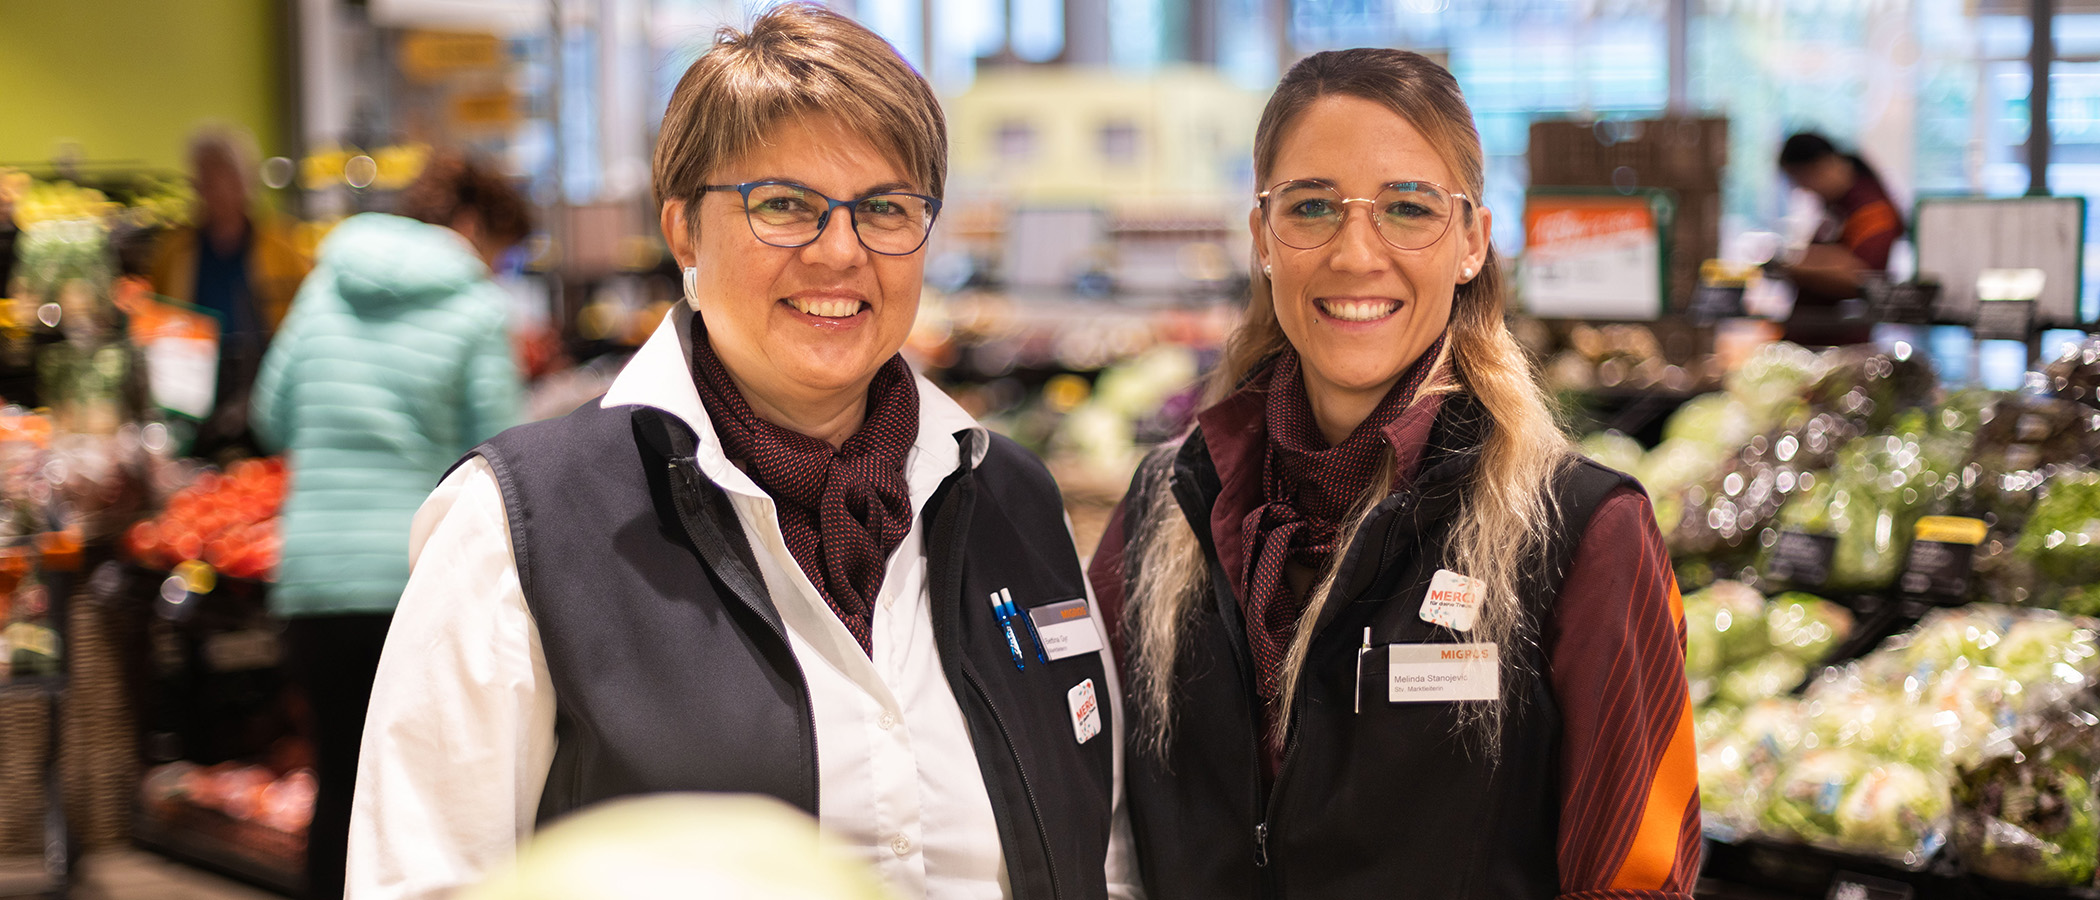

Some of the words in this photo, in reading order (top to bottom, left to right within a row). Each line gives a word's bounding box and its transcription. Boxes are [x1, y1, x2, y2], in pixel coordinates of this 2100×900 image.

[1430, 590, 1476, 604] MERCI
[1061, 606, 1087, 619] MIGROS
[1441, 649, 1489, 660] MIGROS
[1394, 675, 1425, 683] Melinda
[1076, 694, 1096, 722] MERCI
